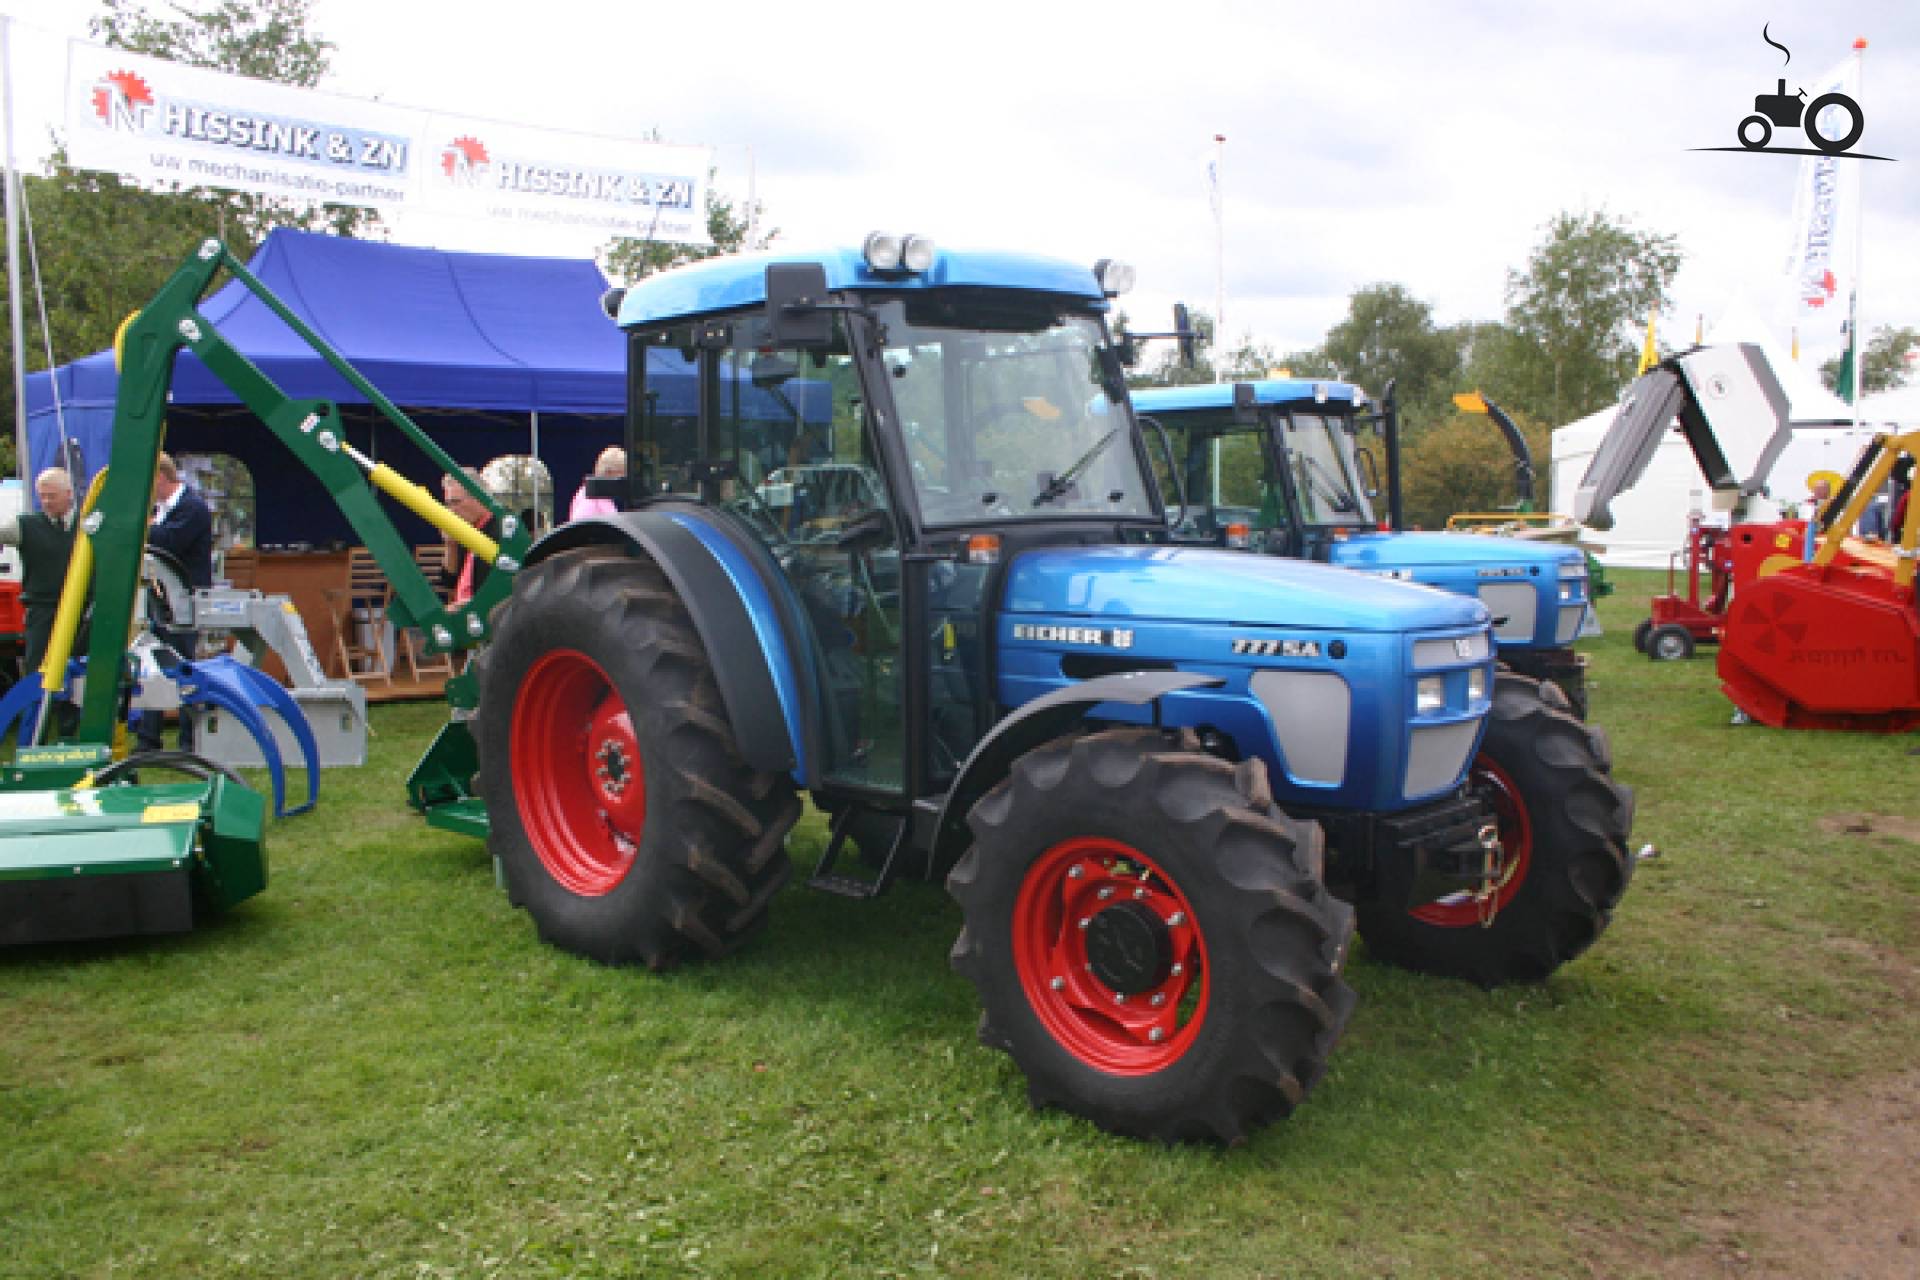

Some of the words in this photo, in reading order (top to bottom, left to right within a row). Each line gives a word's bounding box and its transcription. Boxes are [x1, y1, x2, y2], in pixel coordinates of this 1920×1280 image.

[164, 102, 322, 161] HISSINK
[327, 131, 355, 164] &
[360, 135, 407, 171] ZN
[149, 151, 183, 171] uw
[188, 157, 405, 203] mechanisatie-partner
[498, 162, 624, 203] HISSINK
[628, 177, 651, 206] &
[655, 180, 693, 209] ZN
[1013, 622, 1102, 645] EICHER
